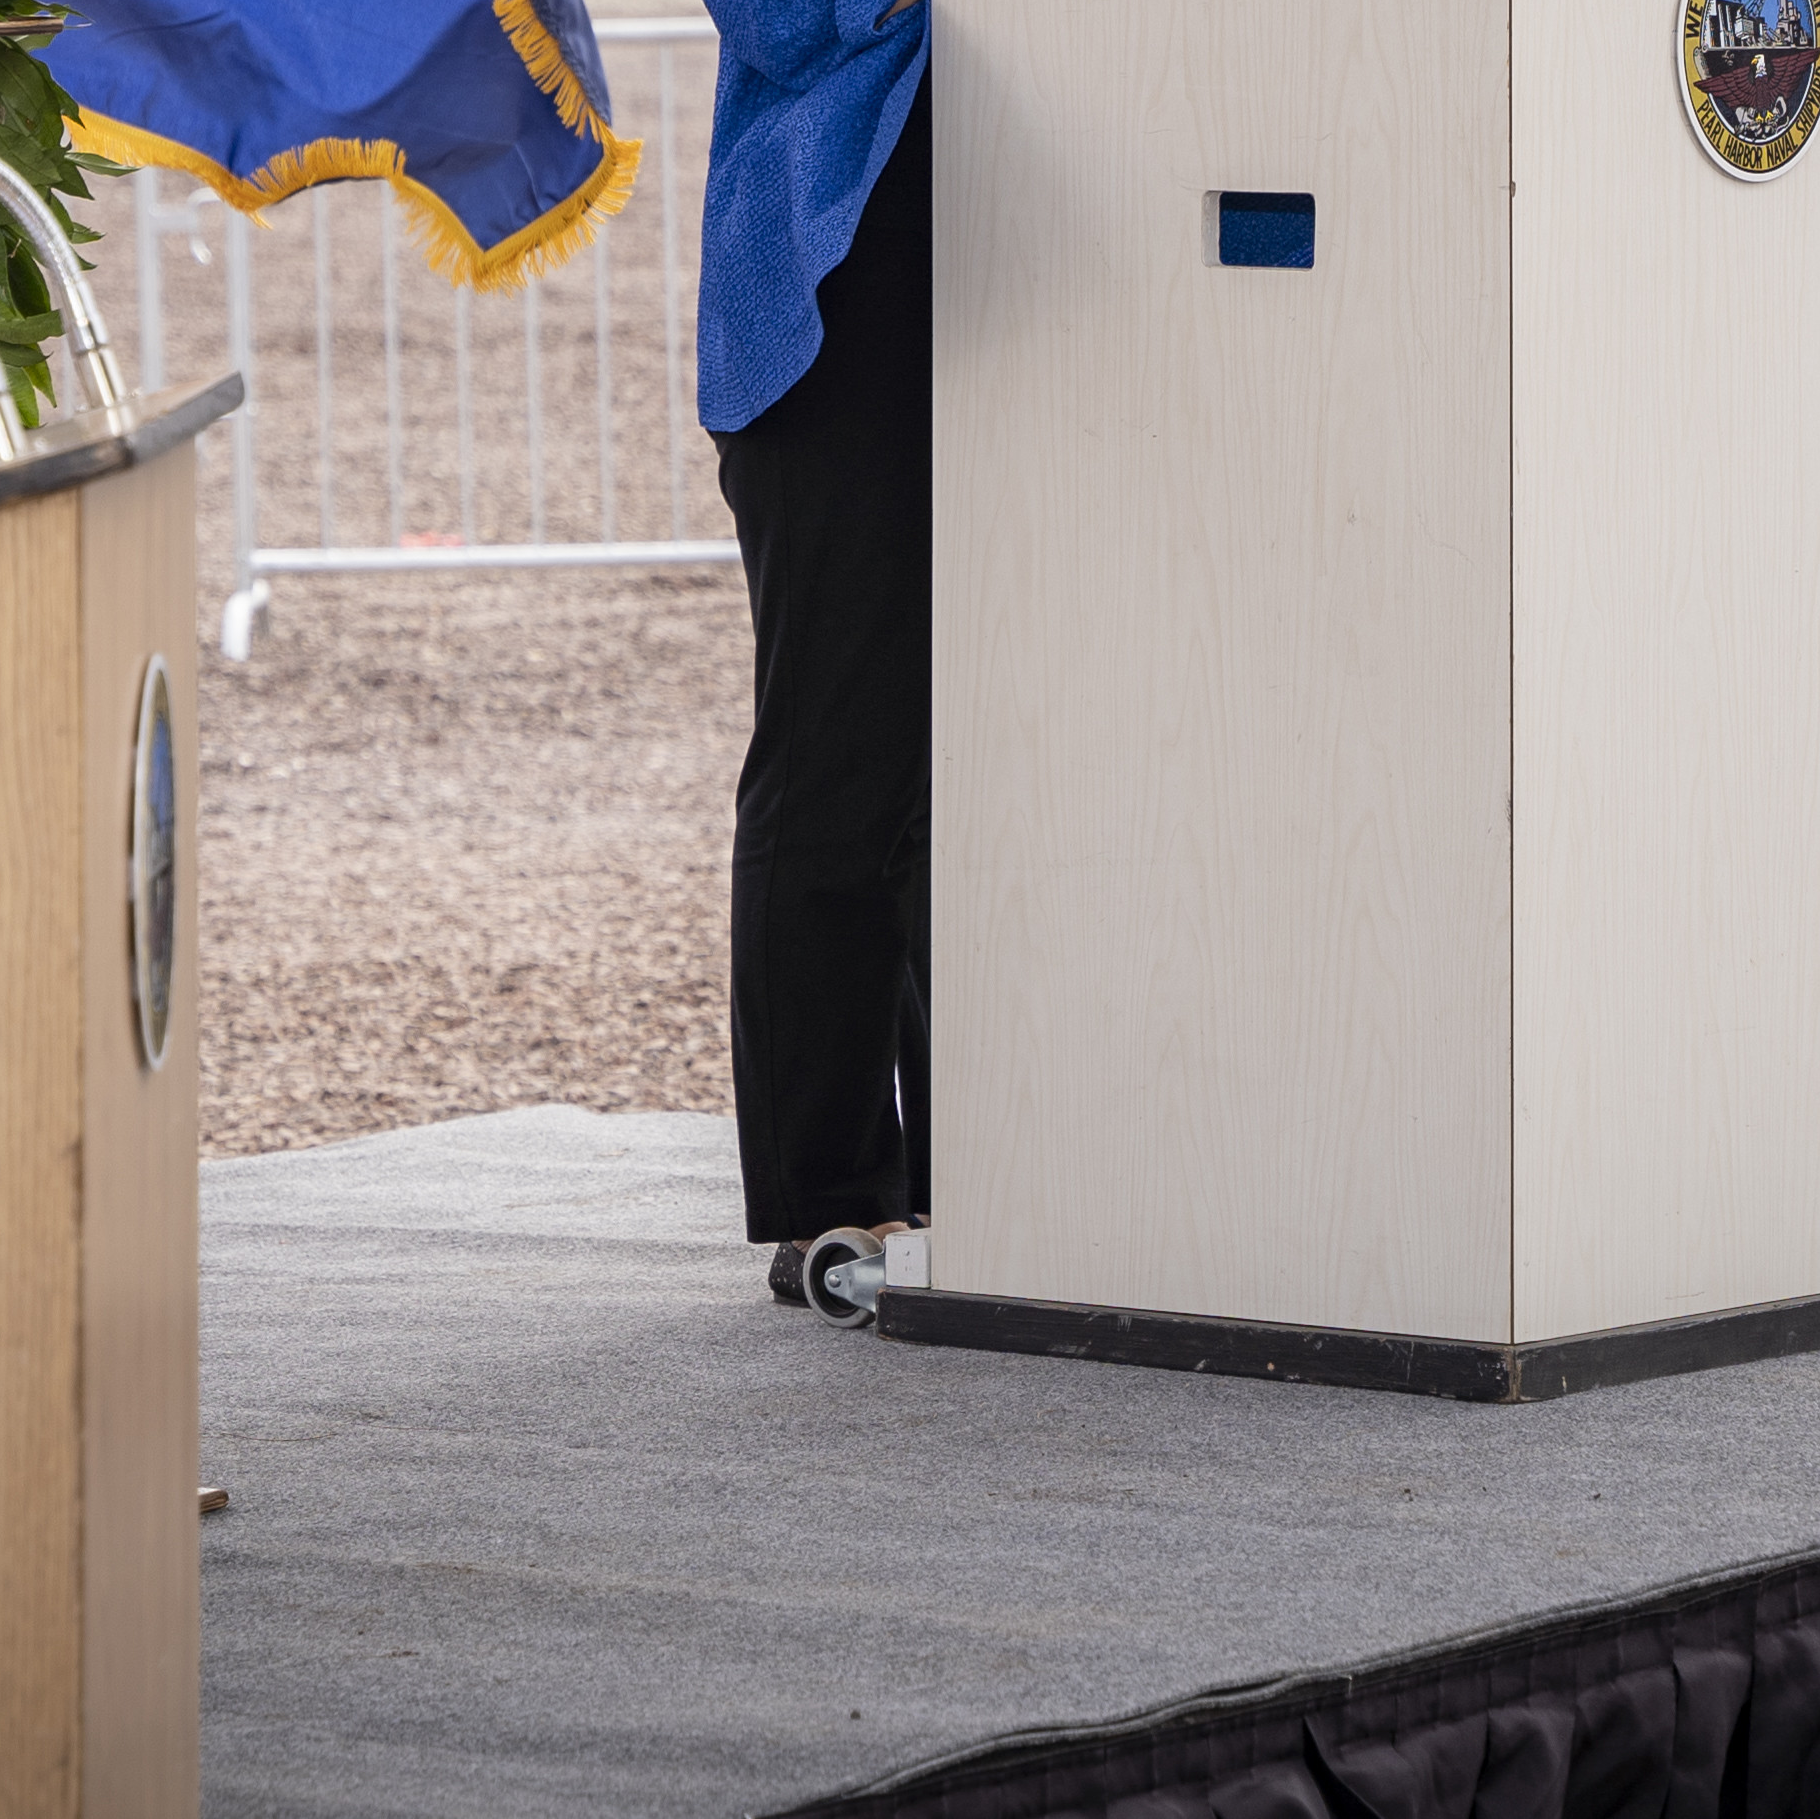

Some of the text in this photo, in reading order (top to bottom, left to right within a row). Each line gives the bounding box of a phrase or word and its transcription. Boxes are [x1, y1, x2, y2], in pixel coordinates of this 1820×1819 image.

[1685, 0, 1703, 38] WE
[1697, 99, 1722, 150] PEARL
[1723, 139, 1763, 169] HARBOR
[1766, 139, 1799, 168] NAVAL
